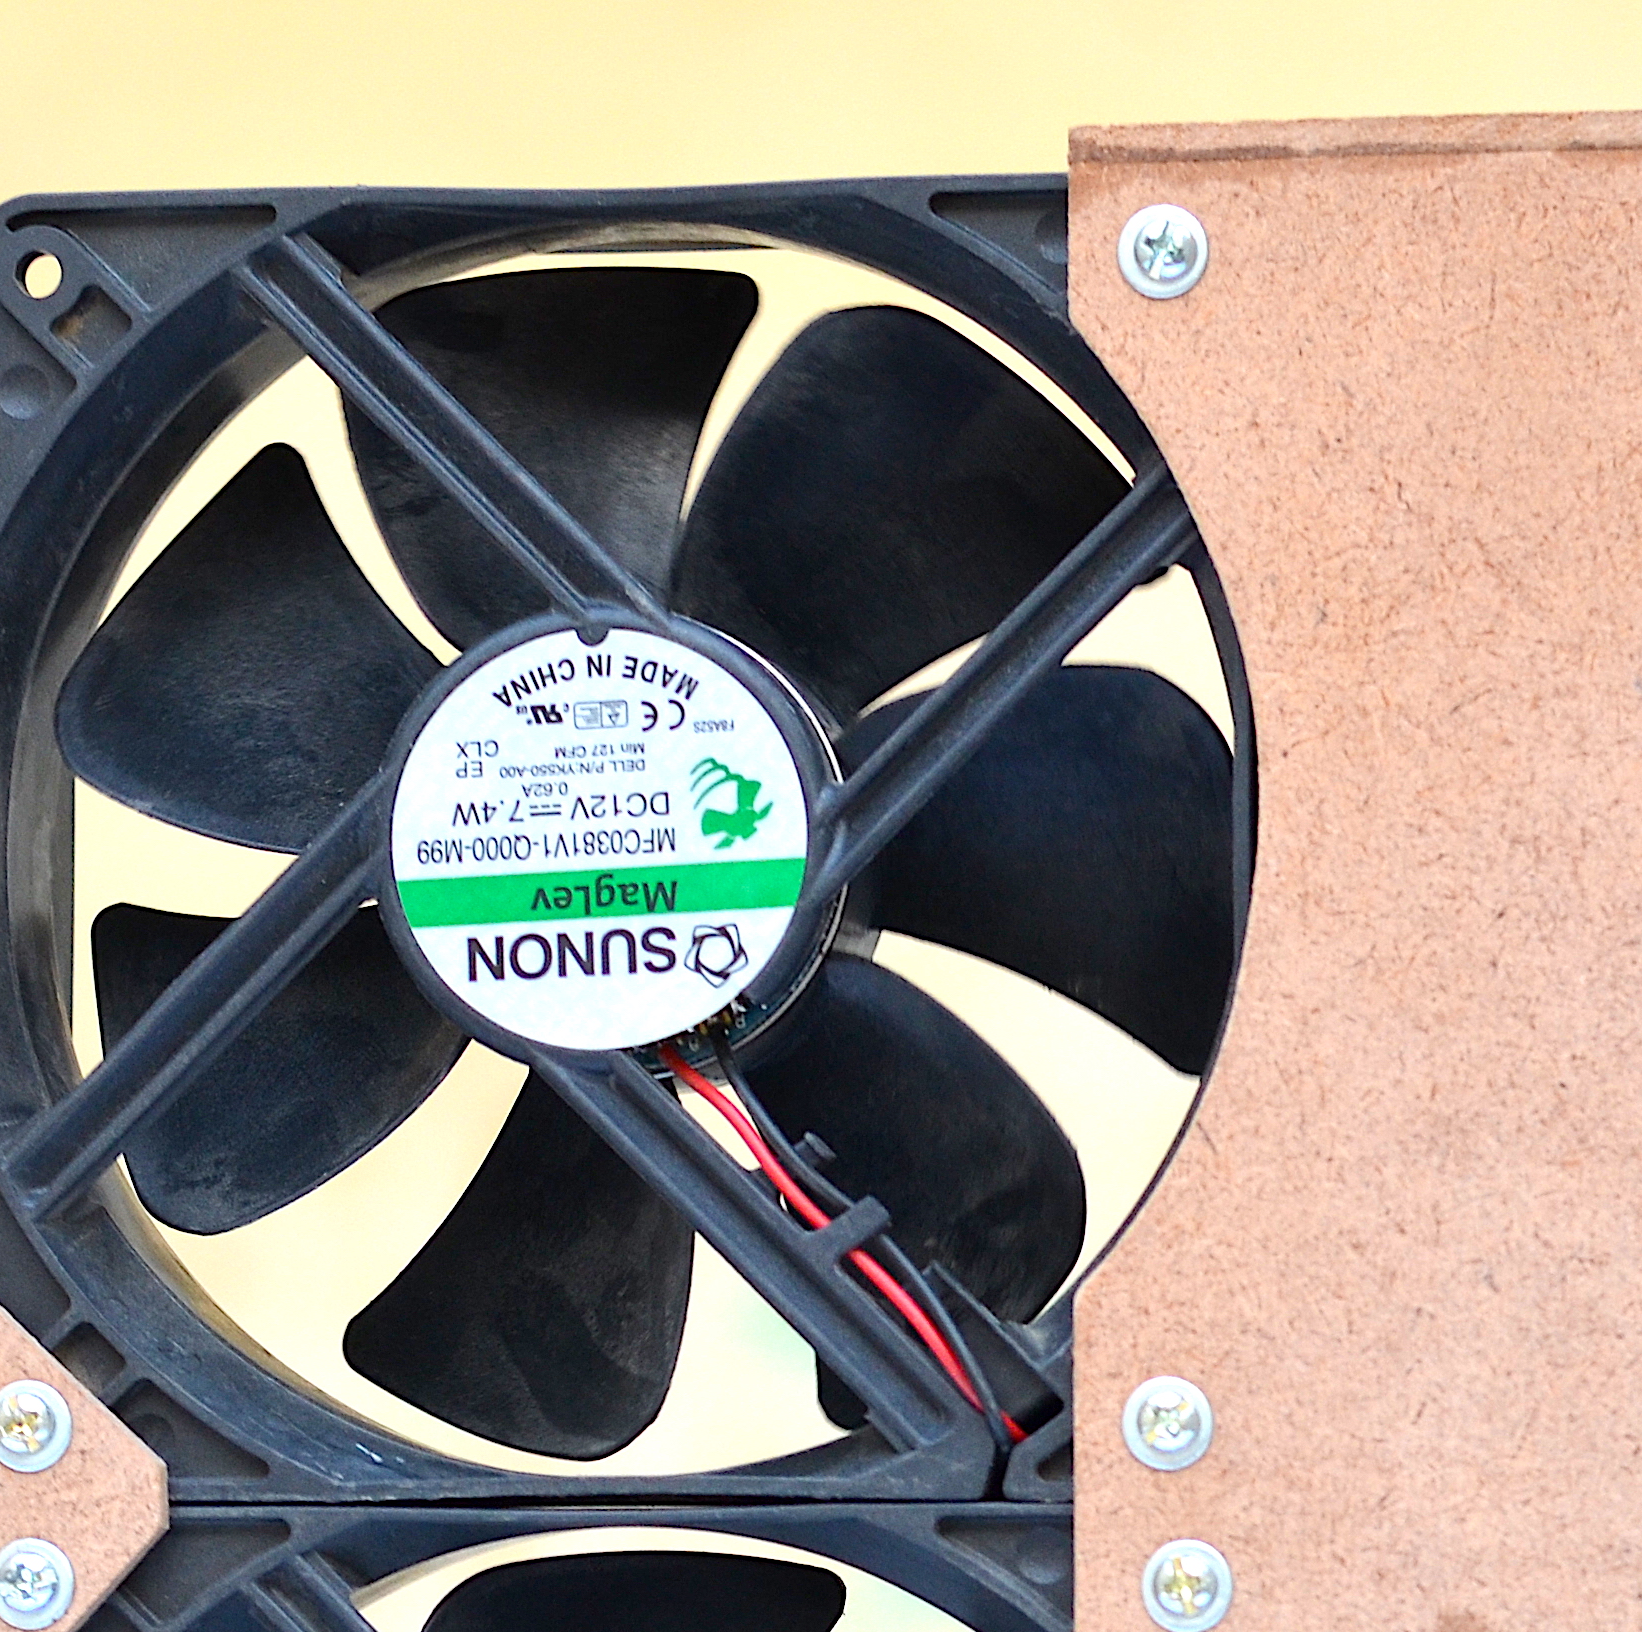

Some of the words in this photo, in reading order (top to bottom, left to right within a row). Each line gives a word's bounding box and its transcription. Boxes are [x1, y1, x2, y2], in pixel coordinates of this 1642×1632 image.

[586, 654, 612, 679] IN
[492, 659, 575, 709] CHINA
[622, 654, 699, 700] MADE
[455, 740, 500, 758] CLX
[554, 745, 586, 759] CFM
[591, 745, 616, 757] 127
[620, 742, 645, 756] Min
[455, 760, 483, 778] EP
[608, 758, 646, 774] DELL
[521, 781, 568, 798] 0.62A
[417, 827, 676, 863] MFC0381V1-Q000-M99
[530, 874, 678, 916] MagLev
[467, 926, 678, 983] SUNON
